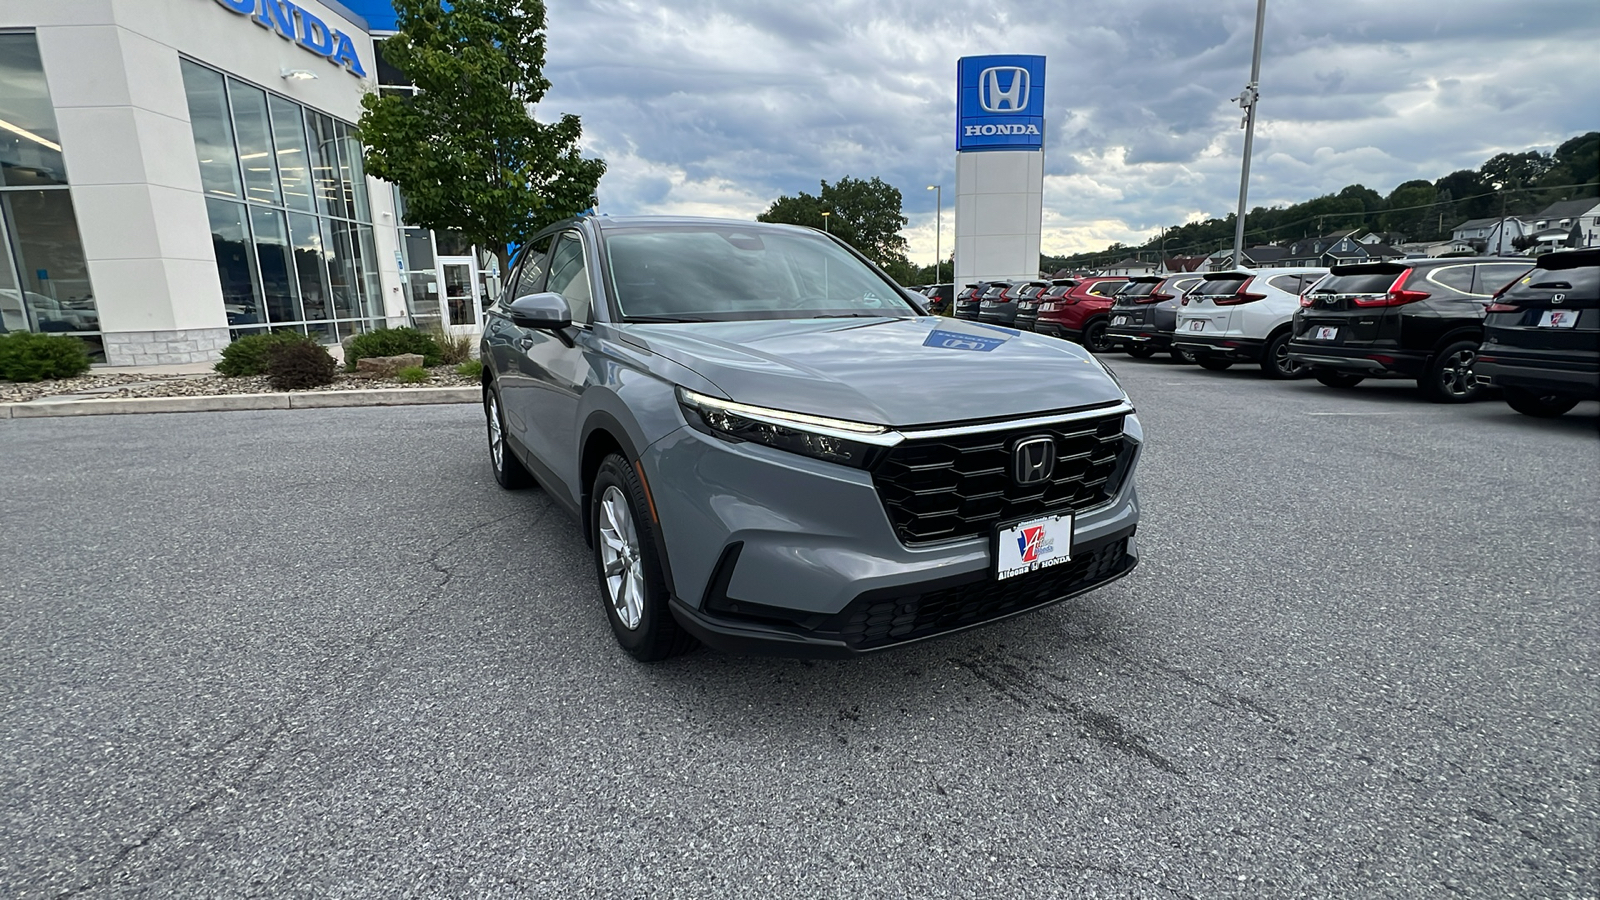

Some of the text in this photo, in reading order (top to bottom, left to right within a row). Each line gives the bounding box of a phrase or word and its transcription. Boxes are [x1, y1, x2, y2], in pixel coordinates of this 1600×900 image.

[964, 124, 1040, 136] HONDA
[998, 555, 1071, 580] Altoona HONDA
